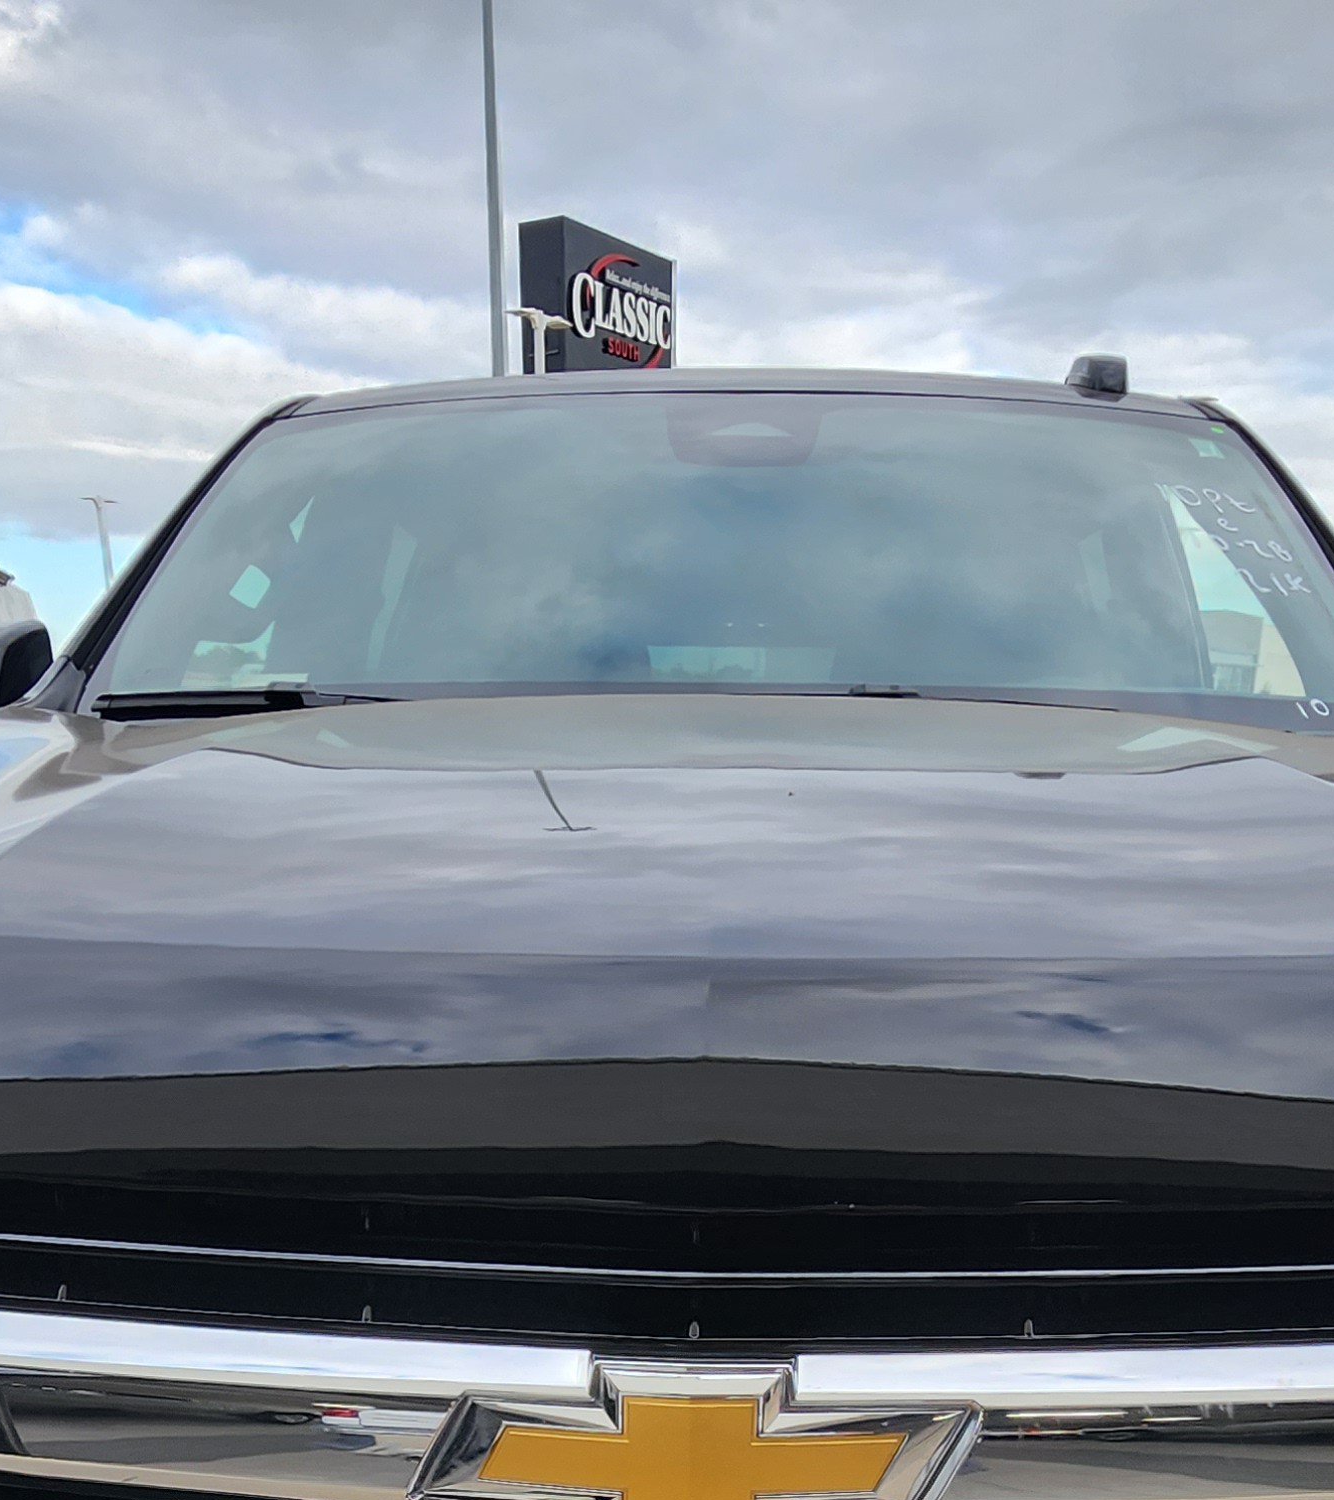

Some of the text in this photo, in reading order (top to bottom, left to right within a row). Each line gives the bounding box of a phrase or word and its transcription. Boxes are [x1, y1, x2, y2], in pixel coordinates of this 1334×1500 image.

[572, 272, 671, 350] CLASSIC
[608, 336, 640, 361] SOUTH
[1296, 698, 1330, 719] 10
